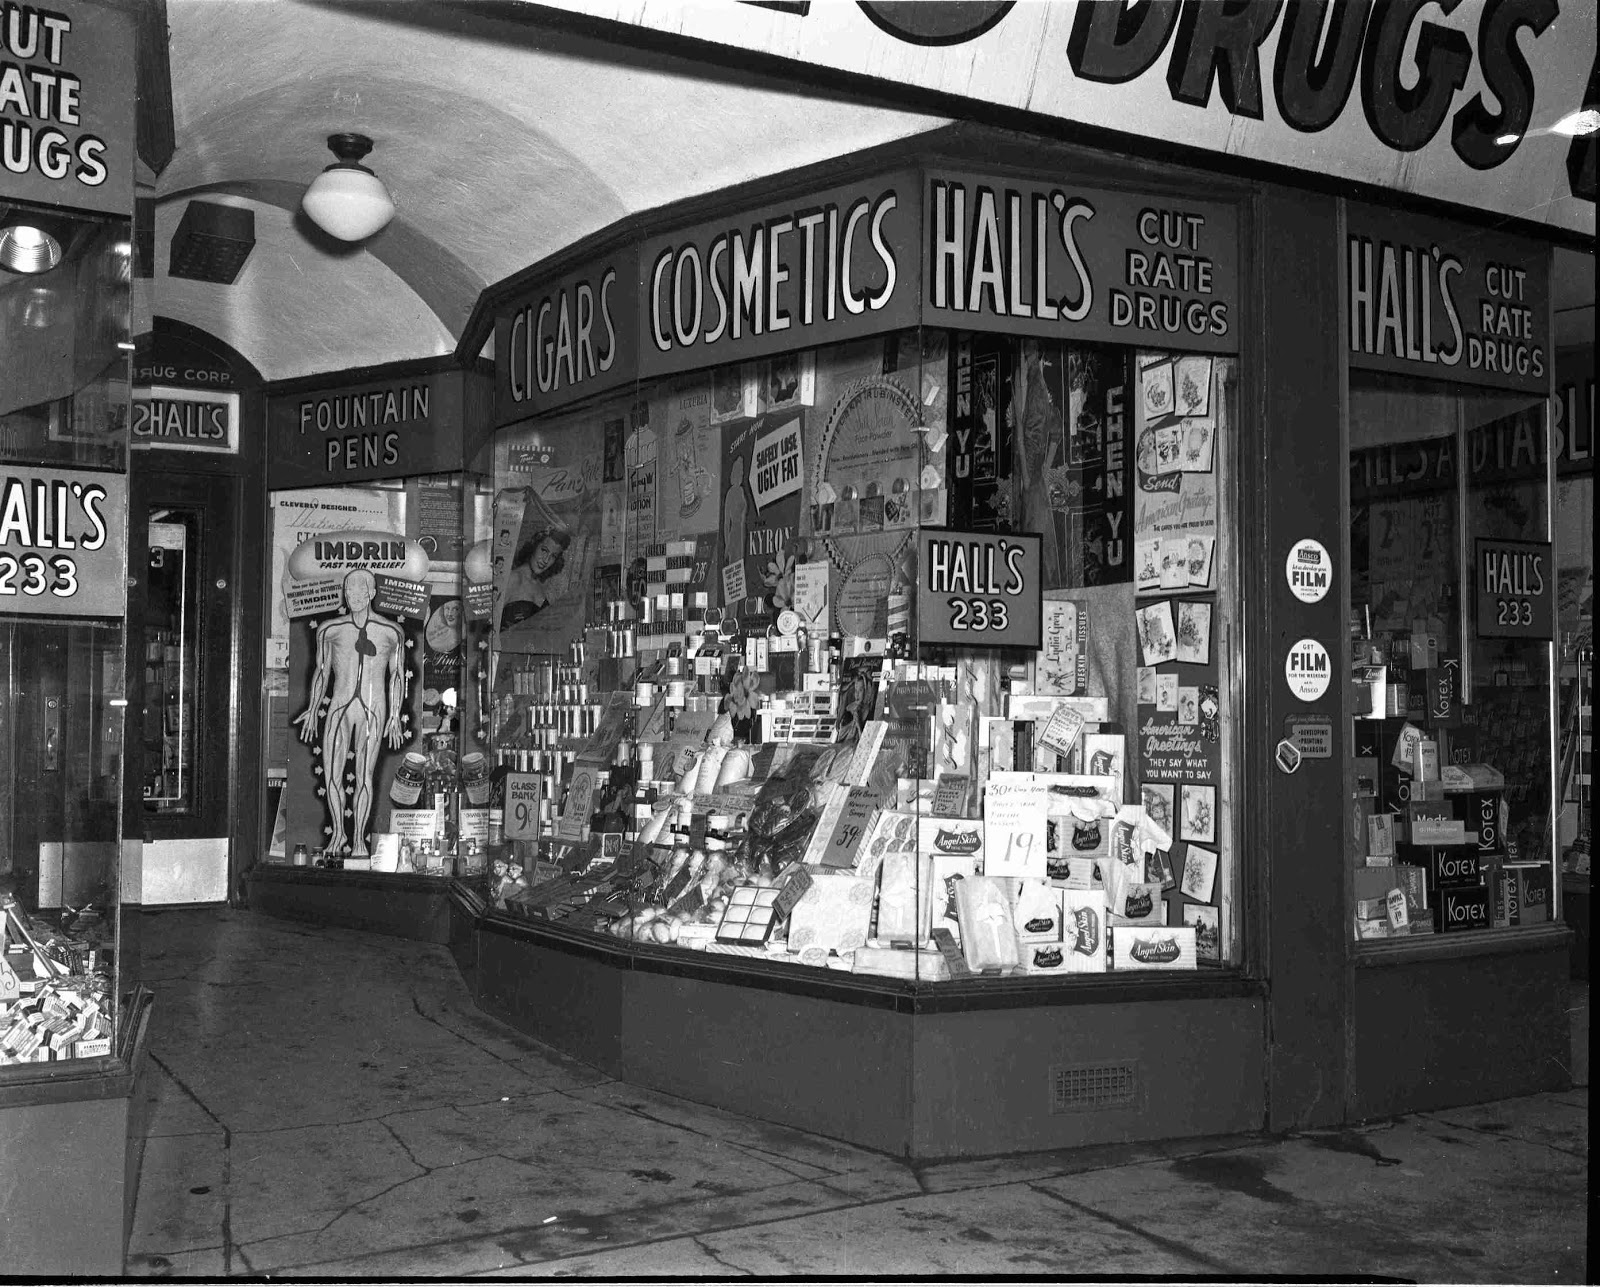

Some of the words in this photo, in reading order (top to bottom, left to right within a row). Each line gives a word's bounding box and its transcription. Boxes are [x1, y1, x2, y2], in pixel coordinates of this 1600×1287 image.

[0, 8, 71, 65] UT
[0, 67, 81, 126] ATE
[1, 123, 108, 186] UGS
[1139, 210, 1205, 251] CUT
[934, 185, 1096, 322] HALL'S
[652, 196, 898, 352] COSMETICS
[1129, 252, 1213, 294] RATE
[1486, 266, 1527, 301] CUT
[1112, 292, 1229, 336] DRUGS
[1350, 239, 1464, 366] HALL'S
[510, 270, 617, 402] CIGARS
[1482, 303, 1533, 340] RATE
[1468, 337, 1545, 379] DRUGS
[184, 368, 235, 385] CORP.
[955, 341, 972, 419] HEN
[150, 401, 224, 439] HALL'S
[300, 386, 430, 435] FOUNTAIN
[866, 389, 919, 428] RUBINSTEIN
[327, 432, 400, 472] PENS
[756, 441, 779, 470] SAFELY
[780, 431, 798, 457] LOSE
[955, 428, 972, 479] YU
[1106, 384, 1125, 500] CHEN
[757, 461, 780, 495] UGLY
[781, 452, 799, 484] FAT
[1143, 473, 1179, 491] Send
[0, 482, 107, 550] ALL'S
[280, 500, 319, 509] CLEVERLY
[314, 541, 406, 561] IMDRIN
[1105, 510, 1124, 567] YU
[1298, 549, 1320, 560] Ansco
[0, 554, 78, 597] 233
[320, 561, 344, 569] FAST
[346, 561, 369, 569] PAIN
[370, 561, 406, 569] RELIEF!
[931, 540, 1024, 595] HALL'S
[1292, 570, 1327, 588] FILM
[1485, 552, 1544, 596] HALL'S
[300, 592, 339, 606] IMDRIN
[384, 578, 425, 592] IMDRIN
[951, 600, 1010, 631] 233
[1078, 610, 1087, 642] TISSUES
[1497, 600, 1533, 626] 233
[1077, 654, 1086, 687] DOESKIN
[1290, 652, 1326, 671] FILM
[1299, 685, 1319, 694] Ansco
[1139, 716, 1195, 736] American
[1143, 733, 1202, 758] Greetings
[1148, 758, 1167, 767] THEY
[1169, 758, 1182, 767] SAY
[1185, 759, 1208, 768] WHAT
[510, 781, 537, 791] GLASS
[1145, 769, 1159, 778] YOU
[1160, 770, 1183, 779] WANT
[1185, 770, 1194, 779] TO
[1196, 771, 1212, 779] SAY
[511, 791, 537, 803] BANK
[937, 834, 961, 850] Angel
[959, 833, 978, 846] Skin
[1479, 798, 1495, 850] KOTEX
[1438, 852, 1477, 877] KOTEX
[1078, 911, 1090, 929] Skin
[1447, 896, 1487, 922] KOTEX
[1079, 927, 1096, 954] Angel
[1133, 943, 1158, 959] Angel
[1156, 942, 1176, 954] Skin
